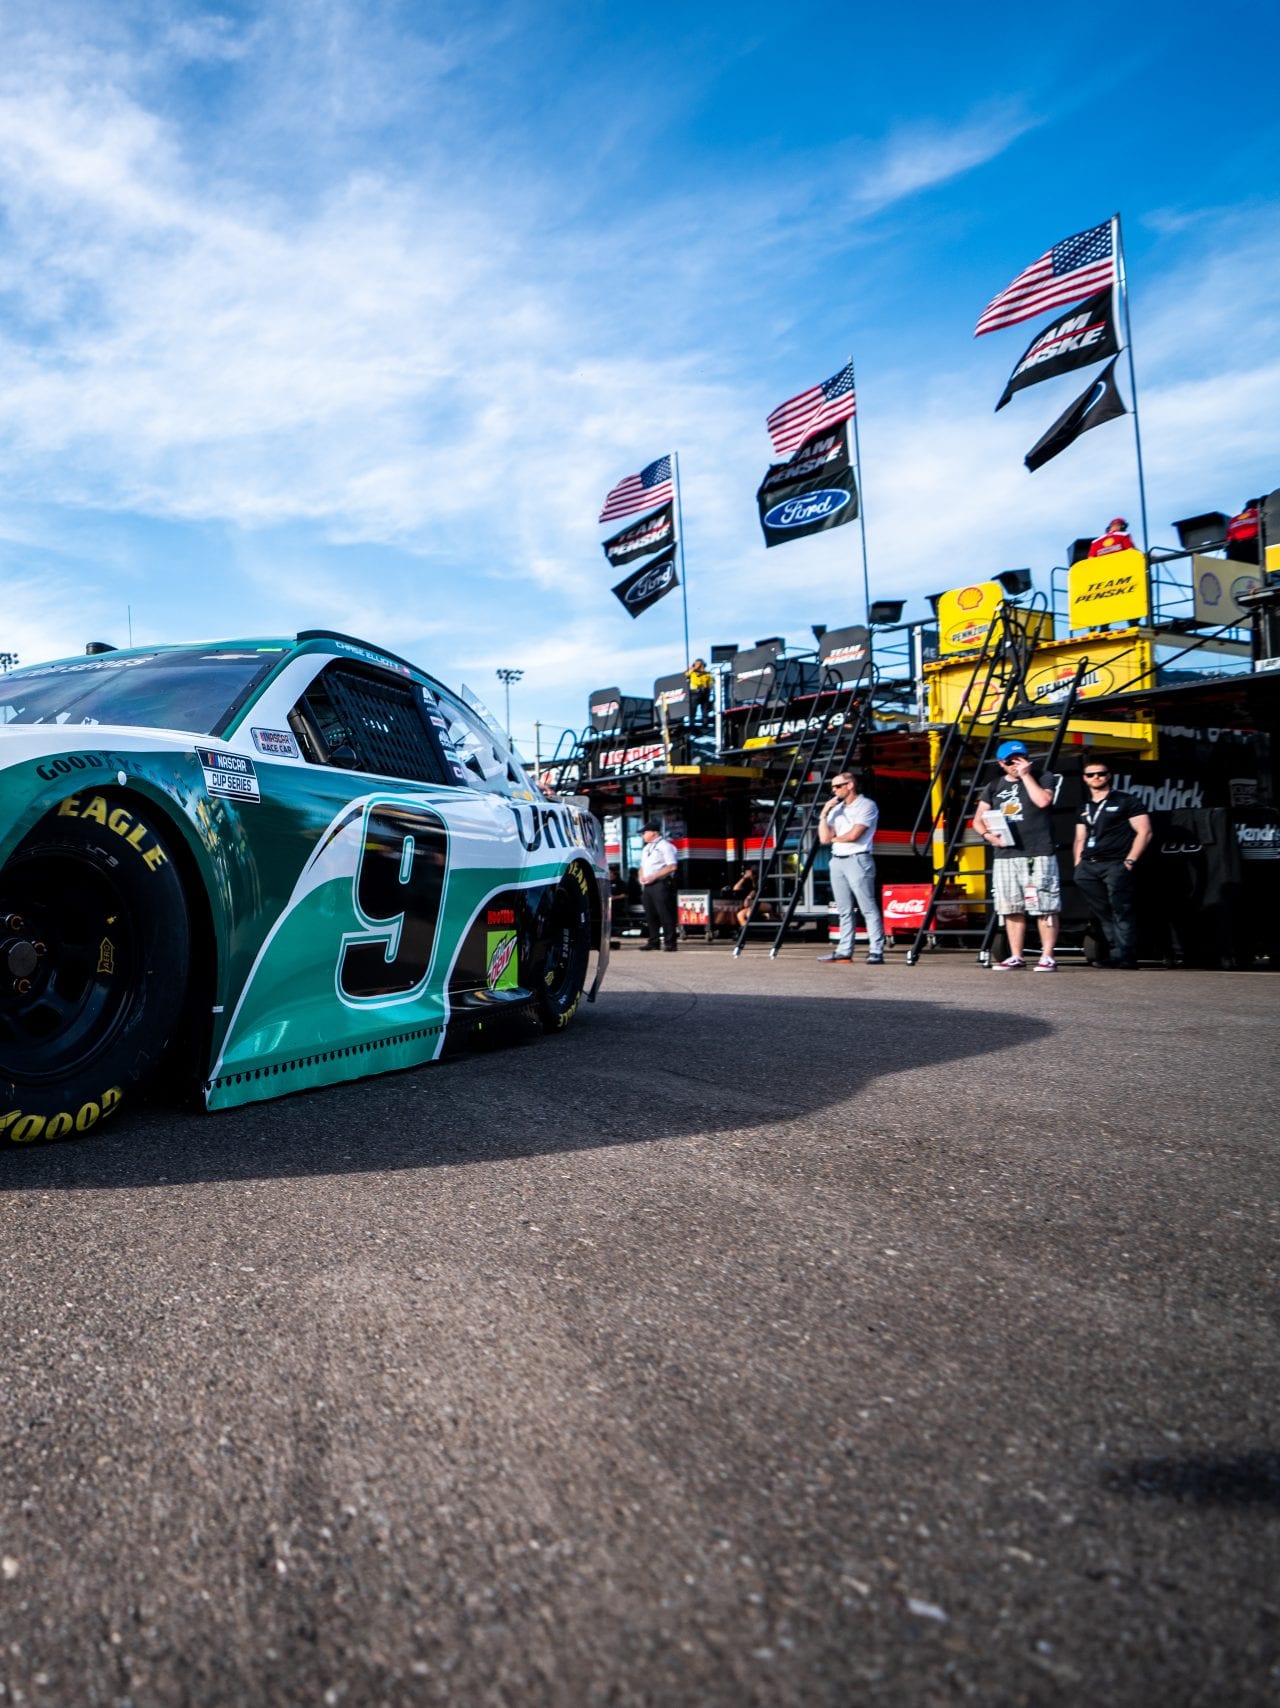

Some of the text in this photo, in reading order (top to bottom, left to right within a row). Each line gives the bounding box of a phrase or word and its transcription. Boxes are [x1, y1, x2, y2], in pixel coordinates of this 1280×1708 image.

[799, 435, 836, 460] AM
[781, 495, 832, 524] Ford
[637, 565, 672, 597] Ford
[1087, 575, 1133, 592] TEAM
[1074, 584, 1137, 605] PENSKE
[1036, 671, 1100, 696] PENNOIL
[260, 731, 291, 744] NASCAR
[757, 712, 845, 738] MENARS
[261, 742, 293, 754] RACE CAR
[218, 754, 247, 773] NASCAR
[212, 773, 252, 792] CUP SERIES
[57, 794, 168, 872] EAGLE
[338, 796, 450, 1009] 9
